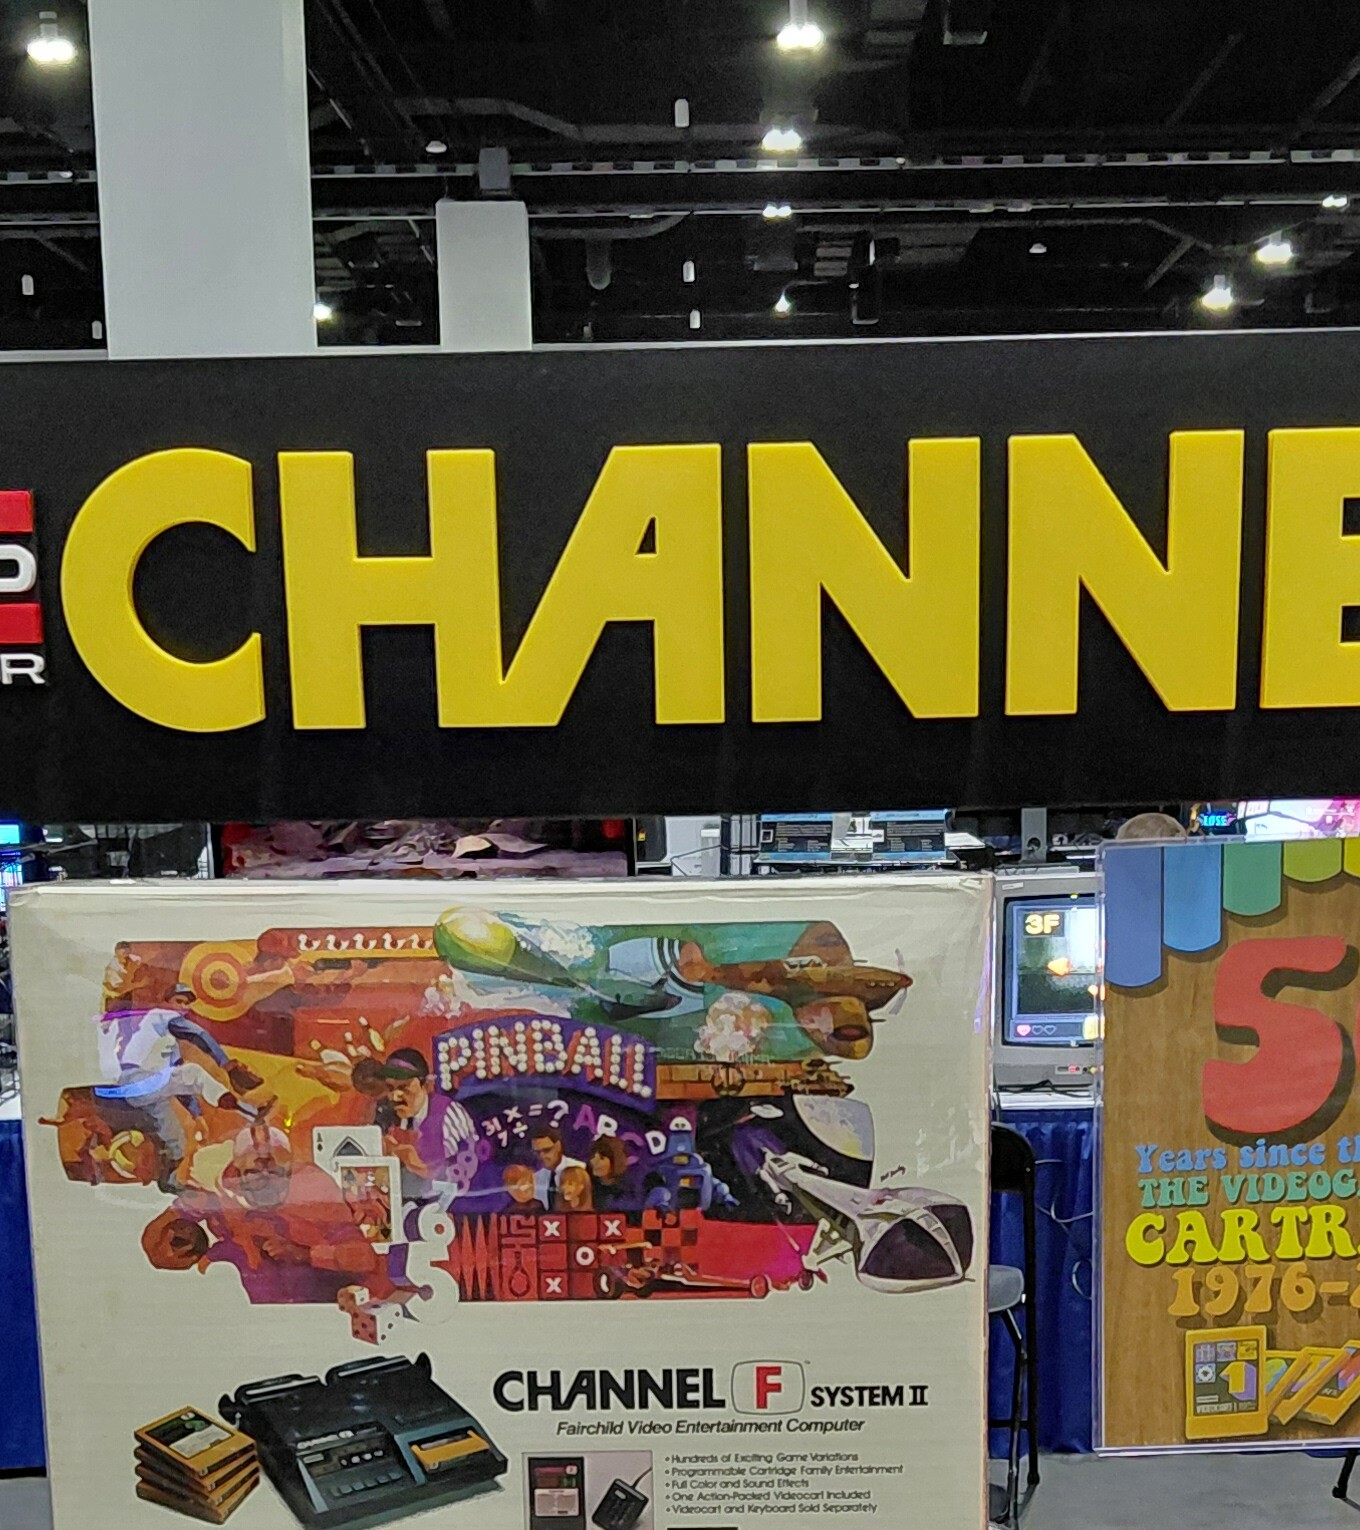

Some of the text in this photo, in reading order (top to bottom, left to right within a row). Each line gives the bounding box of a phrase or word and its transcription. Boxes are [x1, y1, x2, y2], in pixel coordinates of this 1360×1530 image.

[436, 1018, 652, 1098] PINBALL
[1135, 1143, 1227, 1175] Years
[1240, 1139, 1326, 1169] since
[1138, 1176, 1209, 1208] THE
[493, 1366, 928, 1412] CHANNEL F SYSTEM II
[556, 1418, 865, 1437] Fairchild Video Entertainment Computer
[671, 1452, 858, 1465] Hundreds of Exciting Game Variations
[672, 1479, 809, 1489] Full Color and Sound Effects
